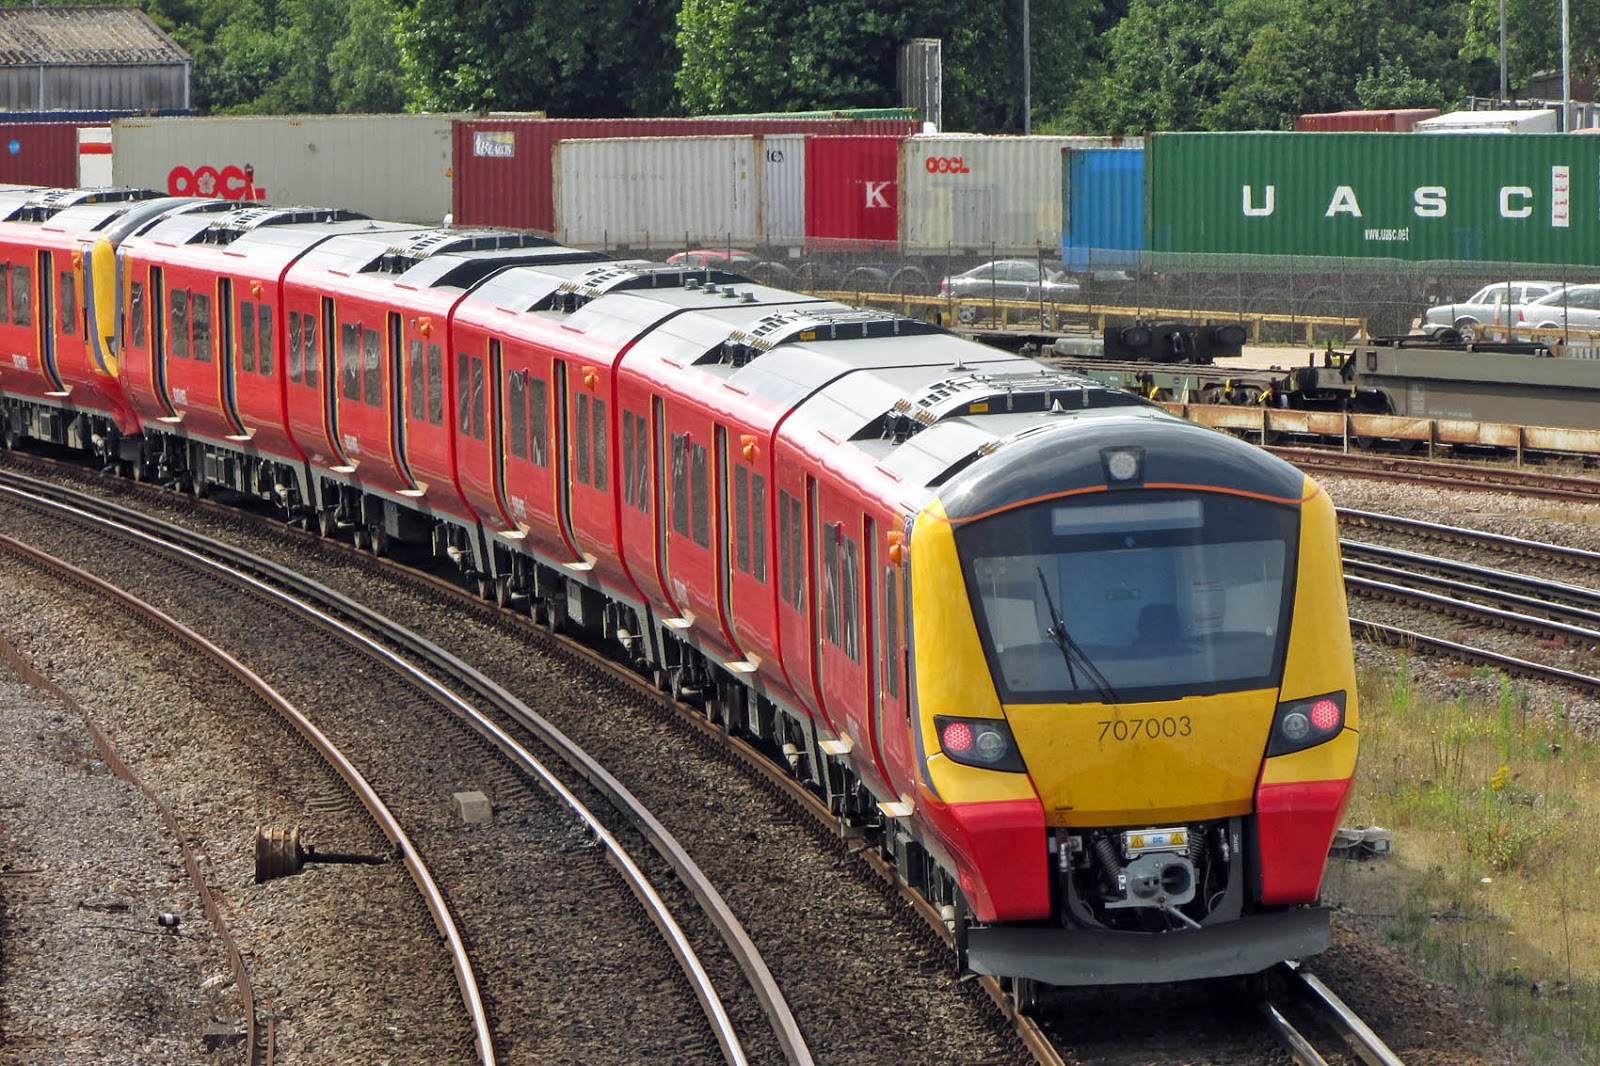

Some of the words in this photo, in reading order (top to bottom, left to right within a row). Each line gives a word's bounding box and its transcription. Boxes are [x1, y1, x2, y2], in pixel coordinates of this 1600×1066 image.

[925, 156, 970, 174] OOCL
[167, 165, 266, 201] OOCL
[1097, 716, 1192, 741] 707003
